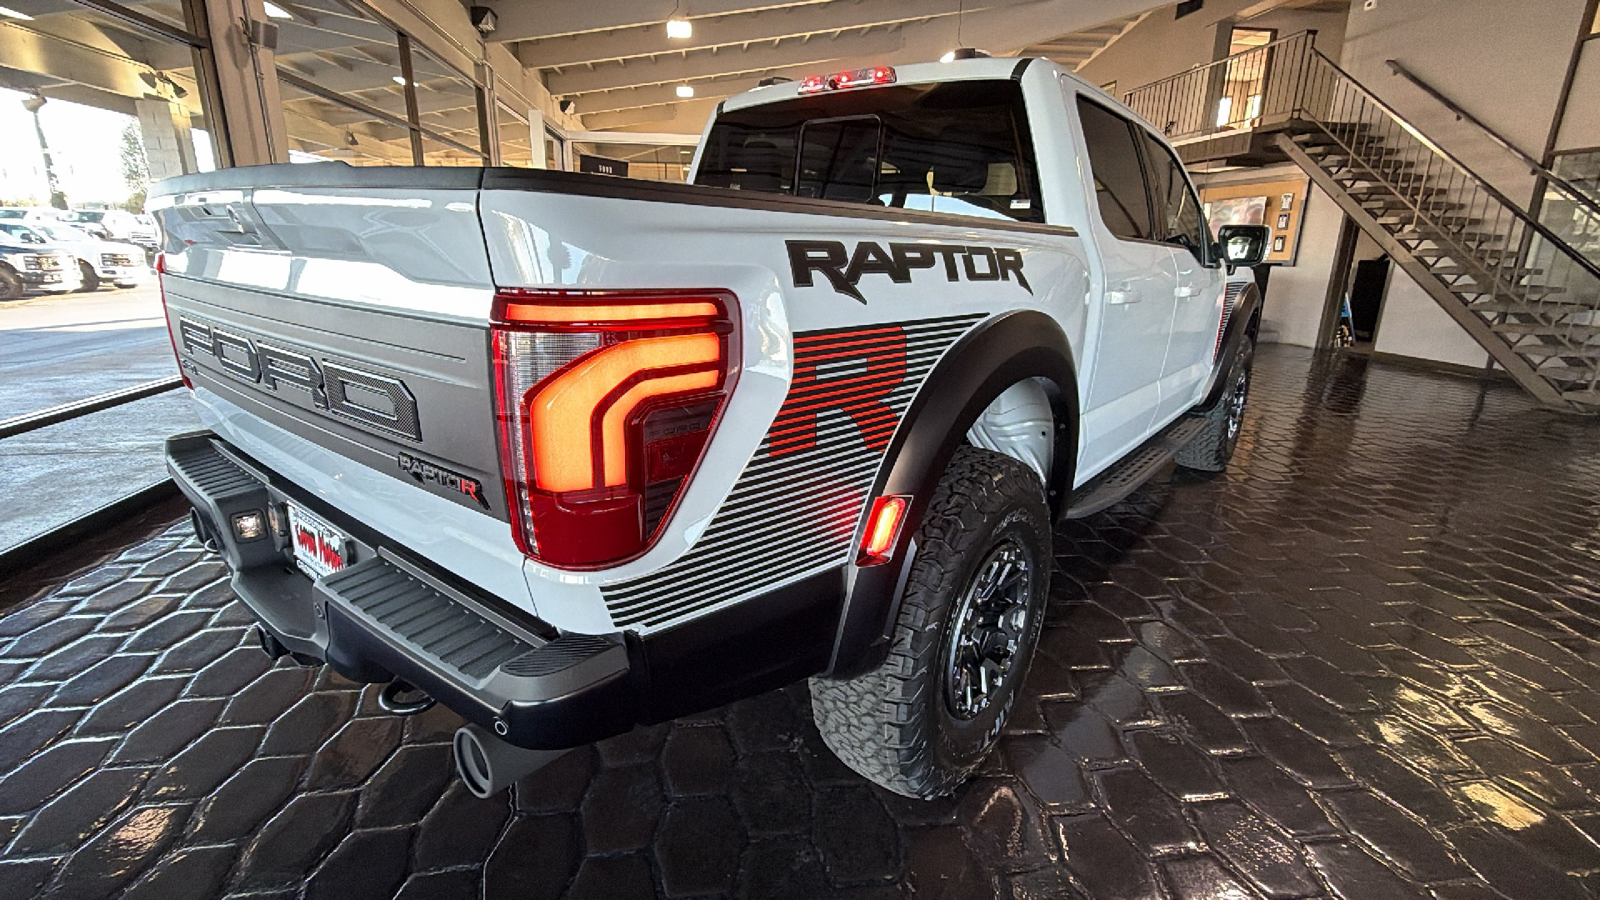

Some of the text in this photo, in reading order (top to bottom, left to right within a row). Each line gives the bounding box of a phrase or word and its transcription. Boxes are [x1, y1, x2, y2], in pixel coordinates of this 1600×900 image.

[785, 240, 1034, 305] RAPTOR
[179, 315, 424, 443] FORD
[398, 452, 487, 507] RAPTOR
